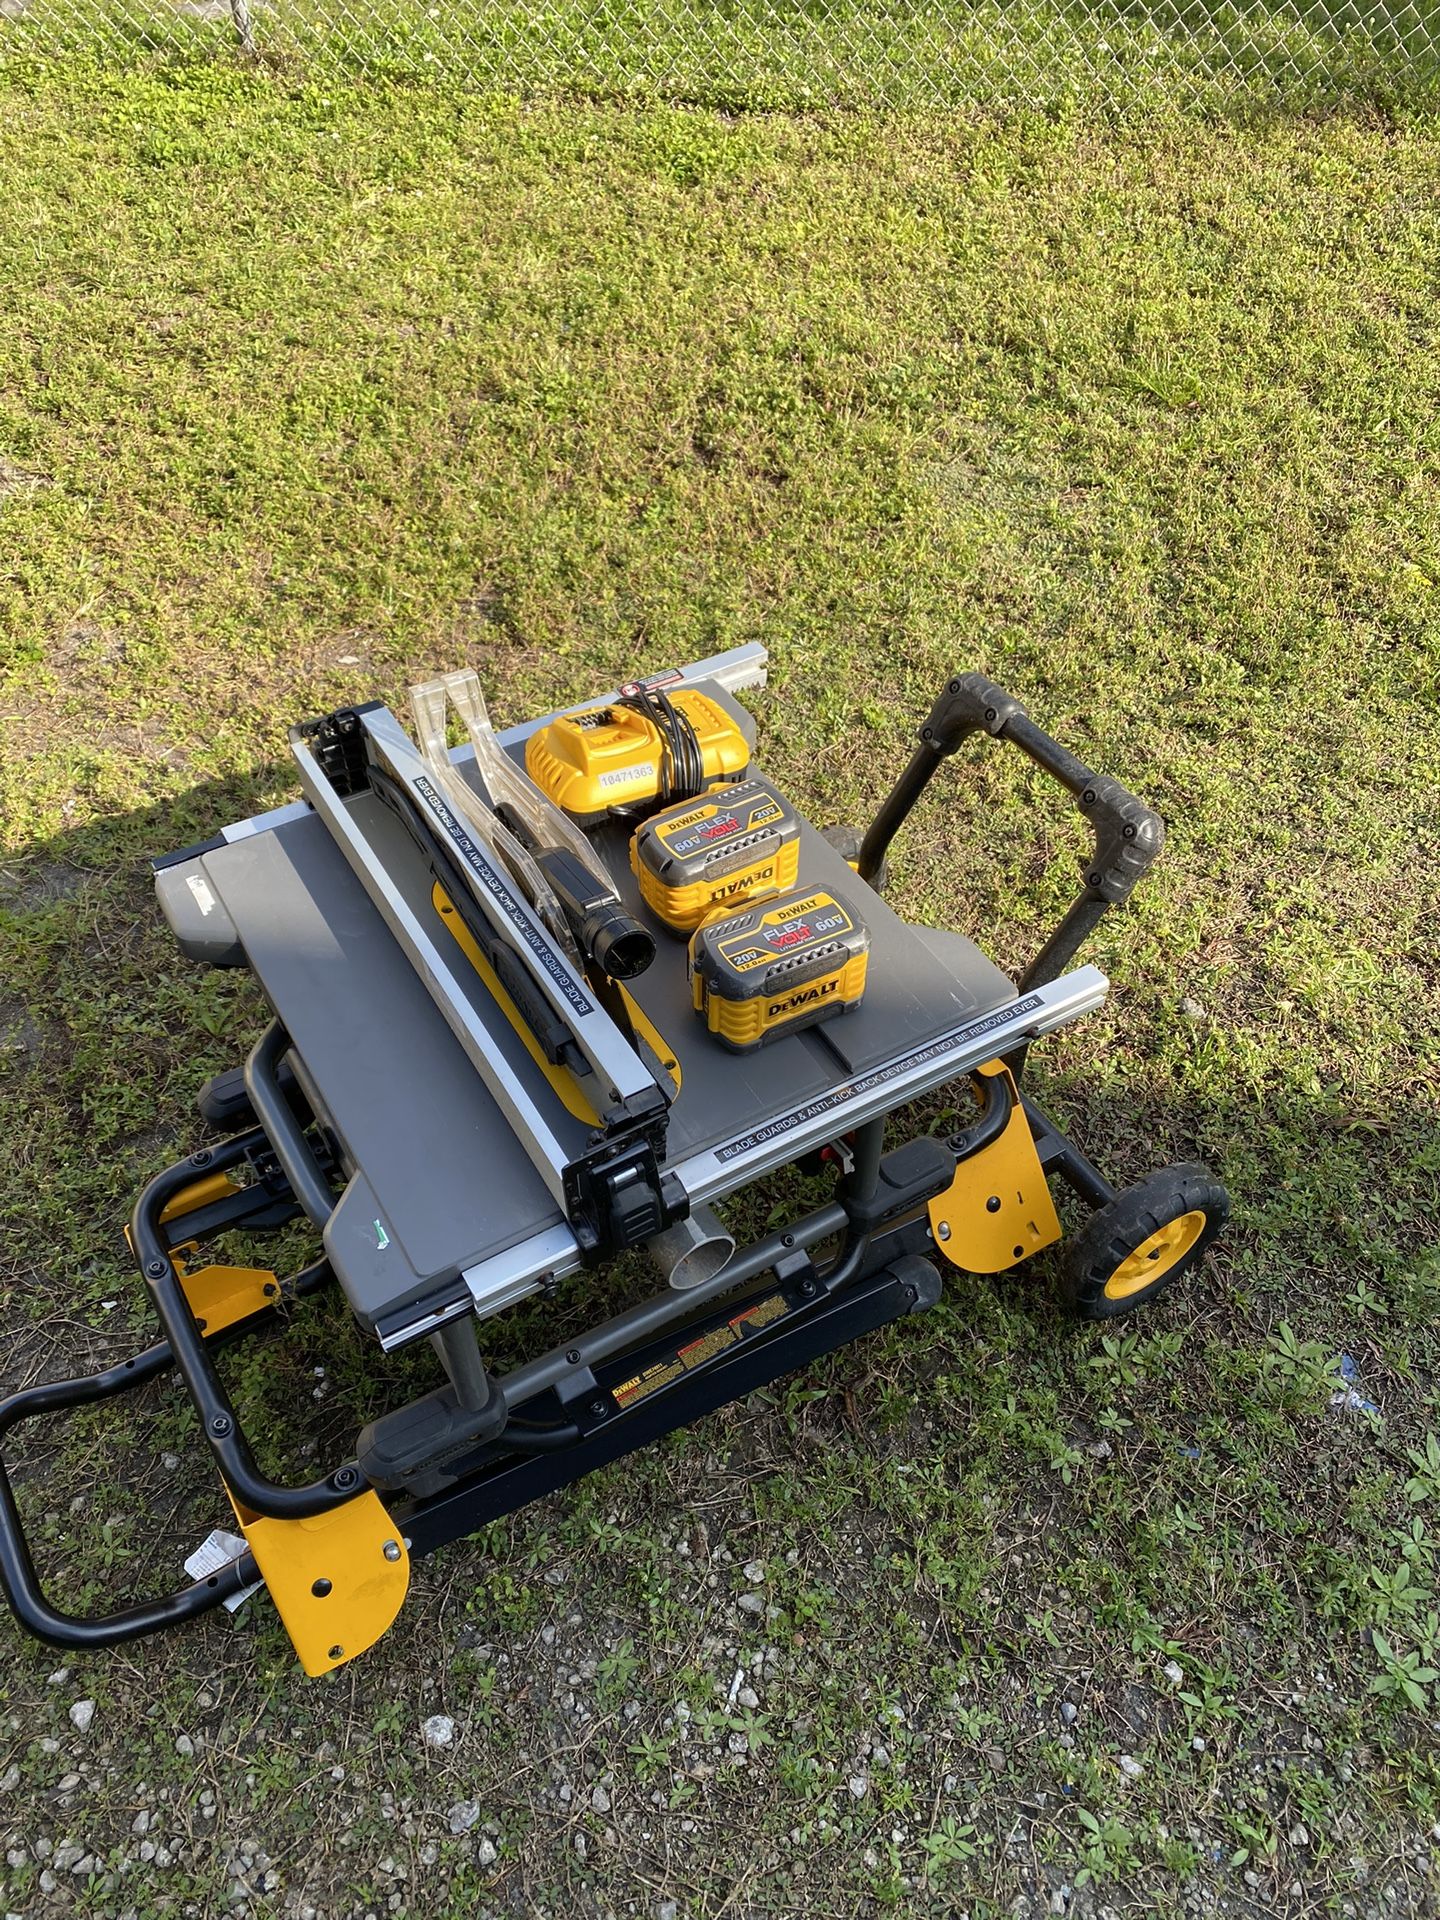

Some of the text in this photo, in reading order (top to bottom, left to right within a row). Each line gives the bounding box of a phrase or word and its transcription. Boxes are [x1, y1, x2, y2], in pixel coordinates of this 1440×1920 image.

[416, 778, 433, 797] EVER
[428, 794, 455, 828] REMOVED
[450, 826, 460, 838] BE
[695, 812, 735, 833] FLEX
[701, 818, 740, 839] VOLT
[458, 837, 472, 852] NOT
[674, 835, 701, 852] 60V
[468, 851, 484, 867] MAY
[478, 865, 503, 892] DEVICE
[499, 892, 520, 913] BACK
[511, 910, 544, 947] ANTI-KICK
[763, 914, 844, 942] FLEX 60V
[770, 926, 812, 948] VOLT
[733, 951, 759, 965] 20V
[543, 953, 571, 986] GUARDS
[565, 987, 589, 1013] BLADE
[768, 980, 839, 1017] DEWALT
[722, 998, 1039, 1159] BLADE GUARDS & ANTI-KICK BACK DEVICE MAY NOT BE REMOVED EVER
